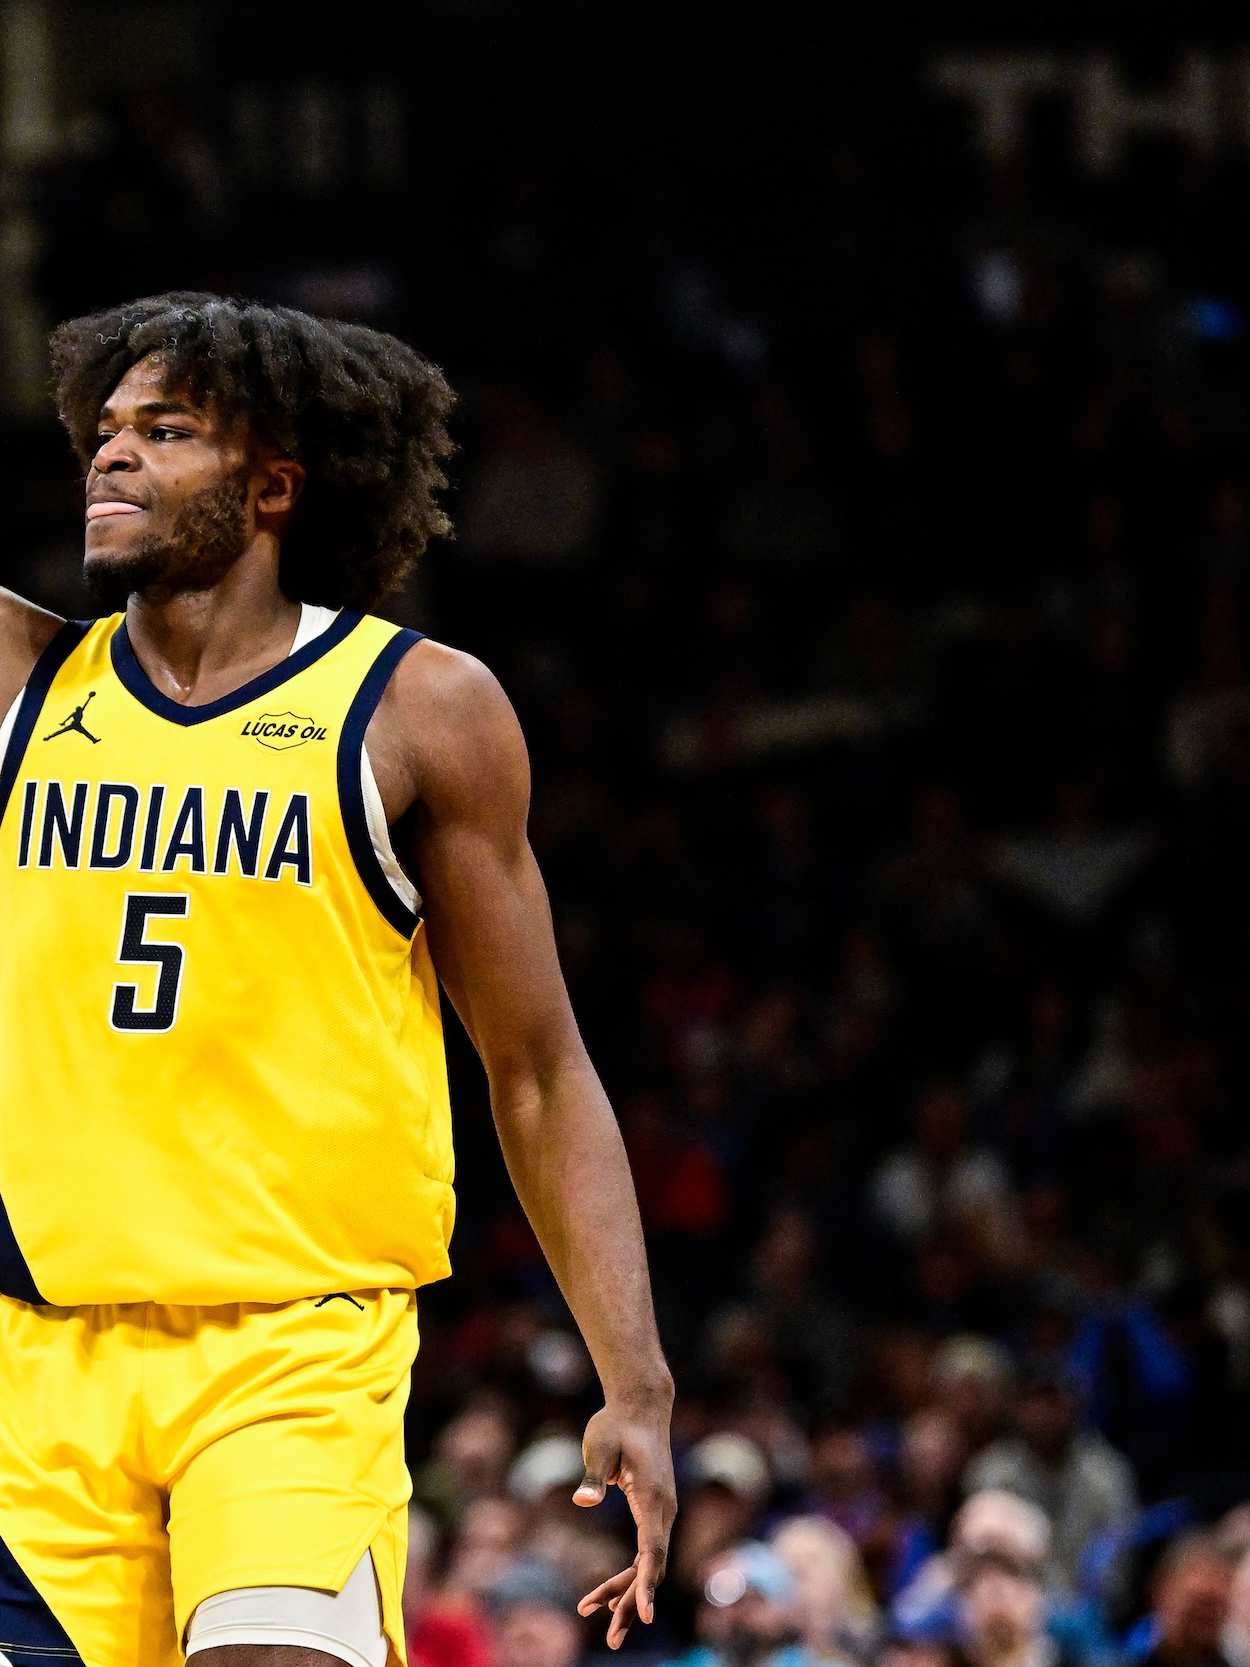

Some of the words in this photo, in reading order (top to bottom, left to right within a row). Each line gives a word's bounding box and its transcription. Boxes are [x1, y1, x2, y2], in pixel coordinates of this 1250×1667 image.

[240, 721, 298, 738] LUCAS
[300, 726, 327, 741] OIL
[17, 779, 314, 888] INDIANA
[108, 891, 190, 1034] 5
